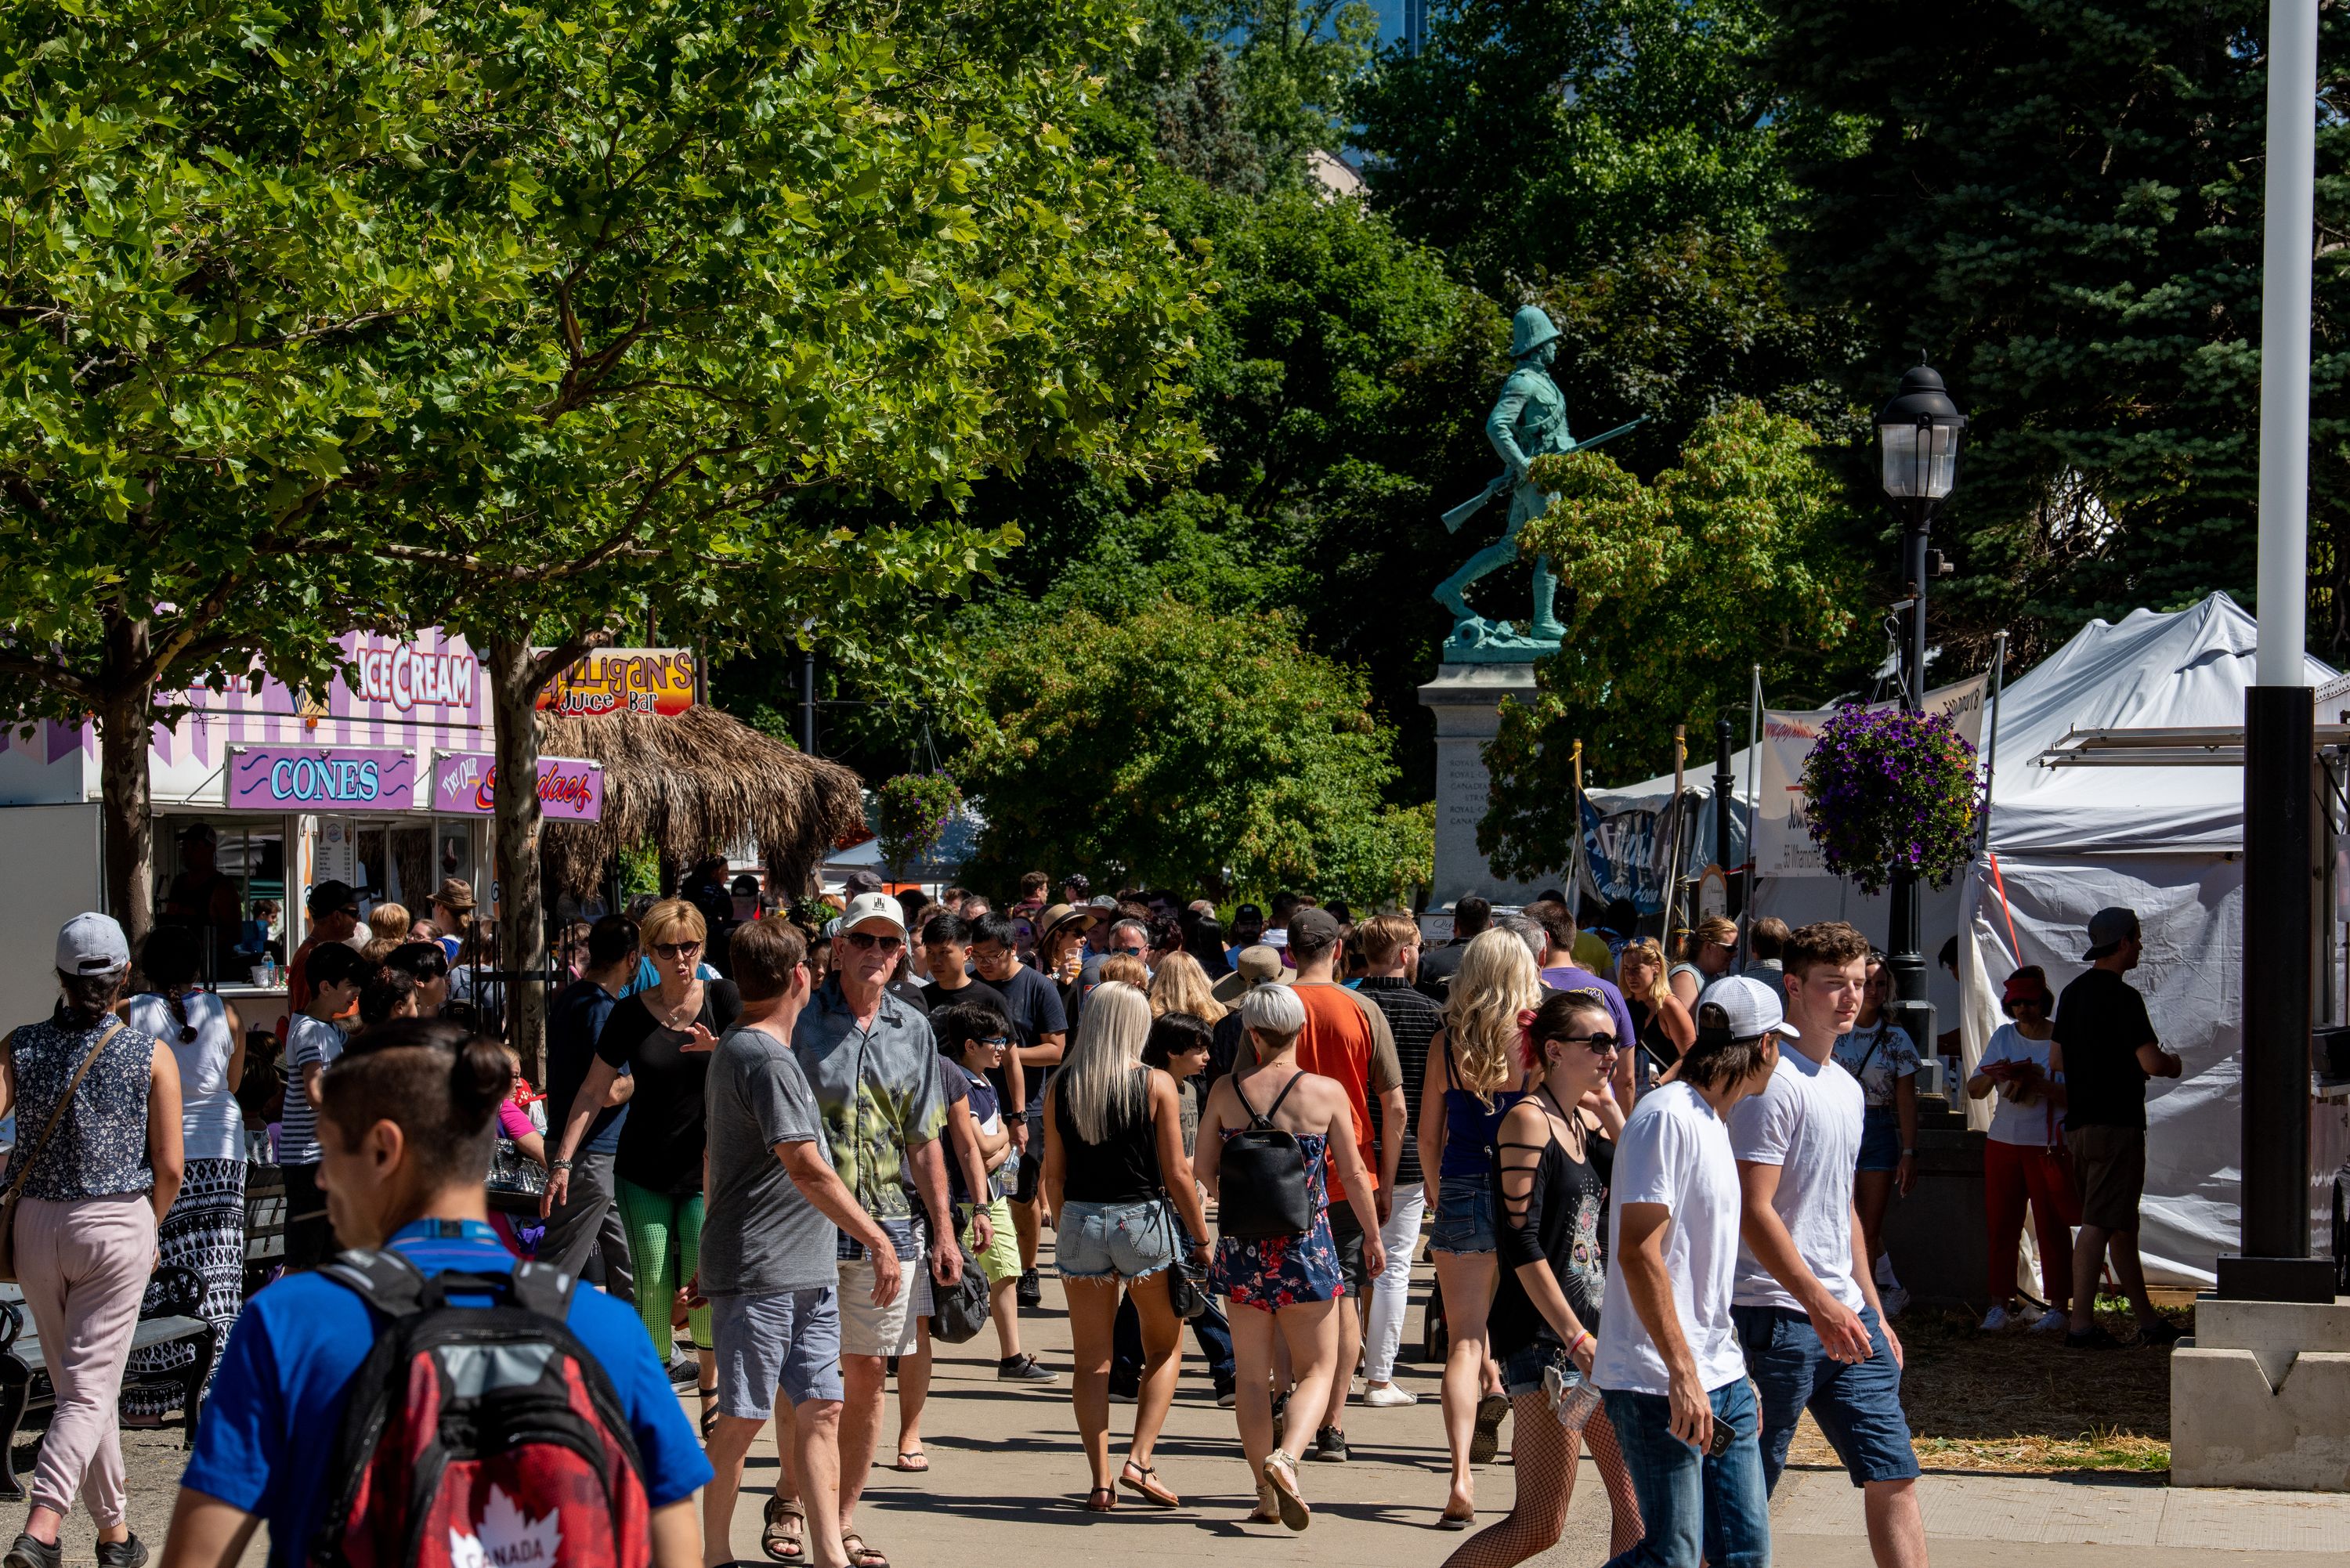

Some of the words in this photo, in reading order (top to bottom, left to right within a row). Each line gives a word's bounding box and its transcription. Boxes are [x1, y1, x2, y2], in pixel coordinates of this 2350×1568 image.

[628, 690, 659, 713] Bar
[270, 757, 379, 801] CONES
[442, 767, 459, 798] TRY
[459, 757, 478, 789] OUR
[475, 762, 593, 813] Sdaes
[1449, 805, 1475, 814] ROYAL
[465, 1537, 544, 1568] CNADA
